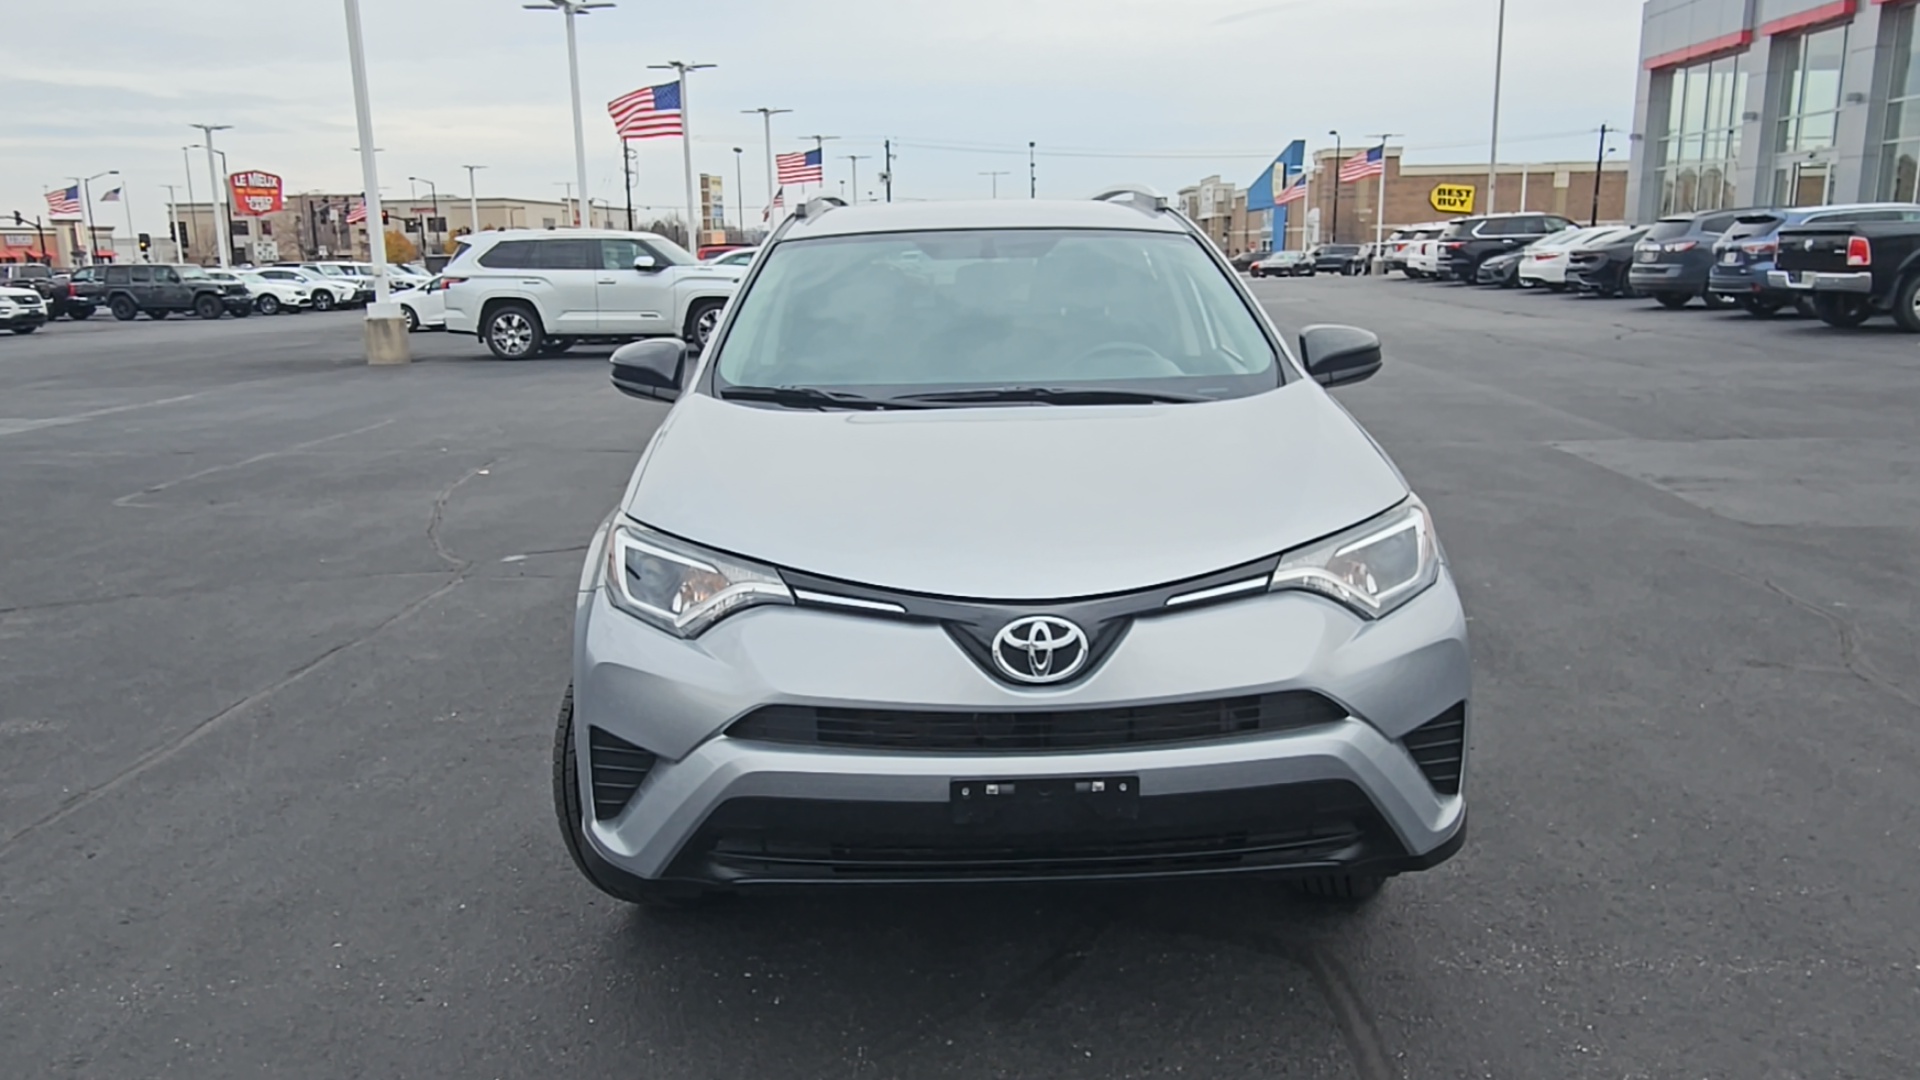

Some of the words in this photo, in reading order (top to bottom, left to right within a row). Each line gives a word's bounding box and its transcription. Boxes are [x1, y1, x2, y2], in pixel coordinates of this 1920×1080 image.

[234, 174, 247, 187] LE
[1437, 188, 1472, 198] BEST
[1437, 198, 1467, 207] BUY
